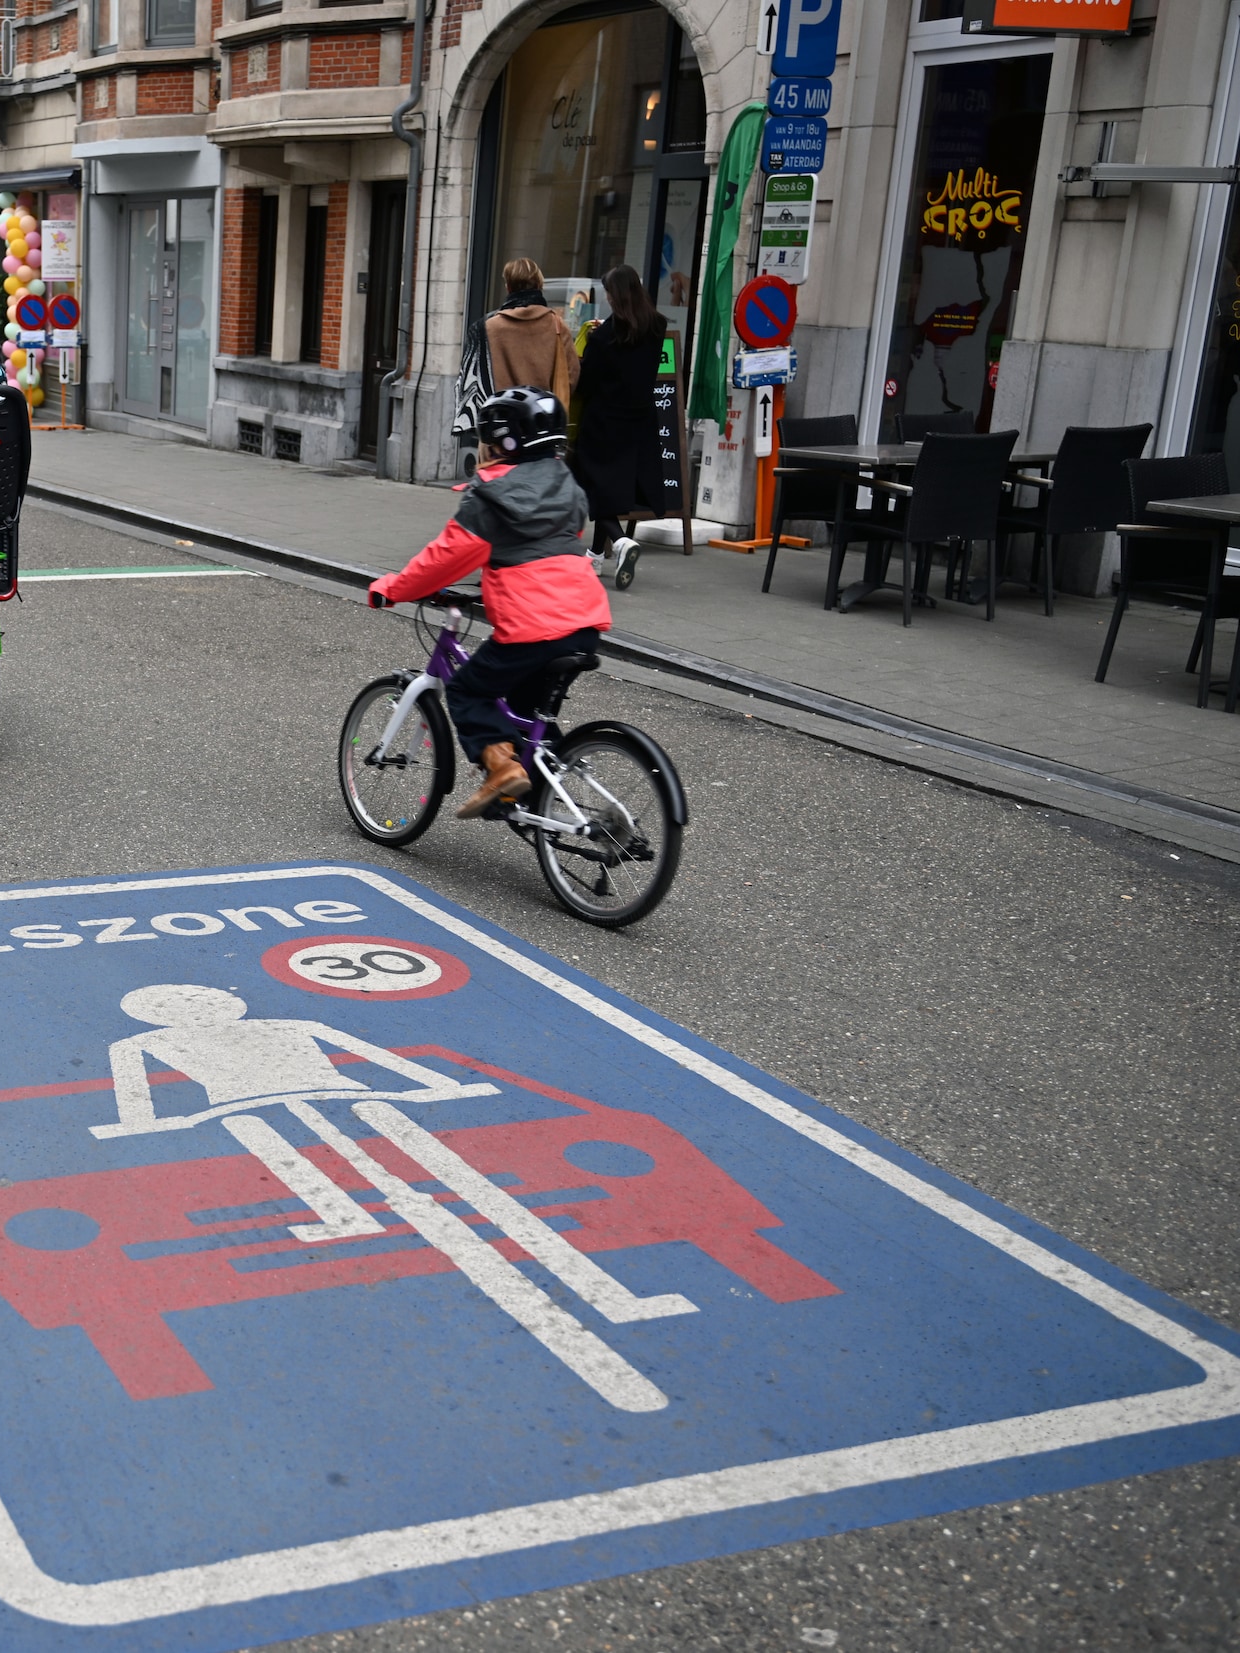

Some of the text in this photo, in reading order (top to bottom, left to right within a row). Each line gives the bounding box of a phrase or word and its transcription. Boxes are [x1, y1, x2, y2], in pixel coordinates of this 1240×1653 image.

[785, 0, 832, 58] P
[774, 84, 830, 109] 45 MIN
[776, 126, 787, 135] VAN
[787, 123, 794, 135] 9
[795, 126, 805, 135] TOT
[770, 138, 822, 151] VAN MAANDAG
[770, 153, 783, 162] TAX
[784, 156, 821, 168] ATERDAG
[773, 181, 807, 193] Shop & Go
[927, 166, 1022, 206] Multi
[301, 950, 426, 982] 30
